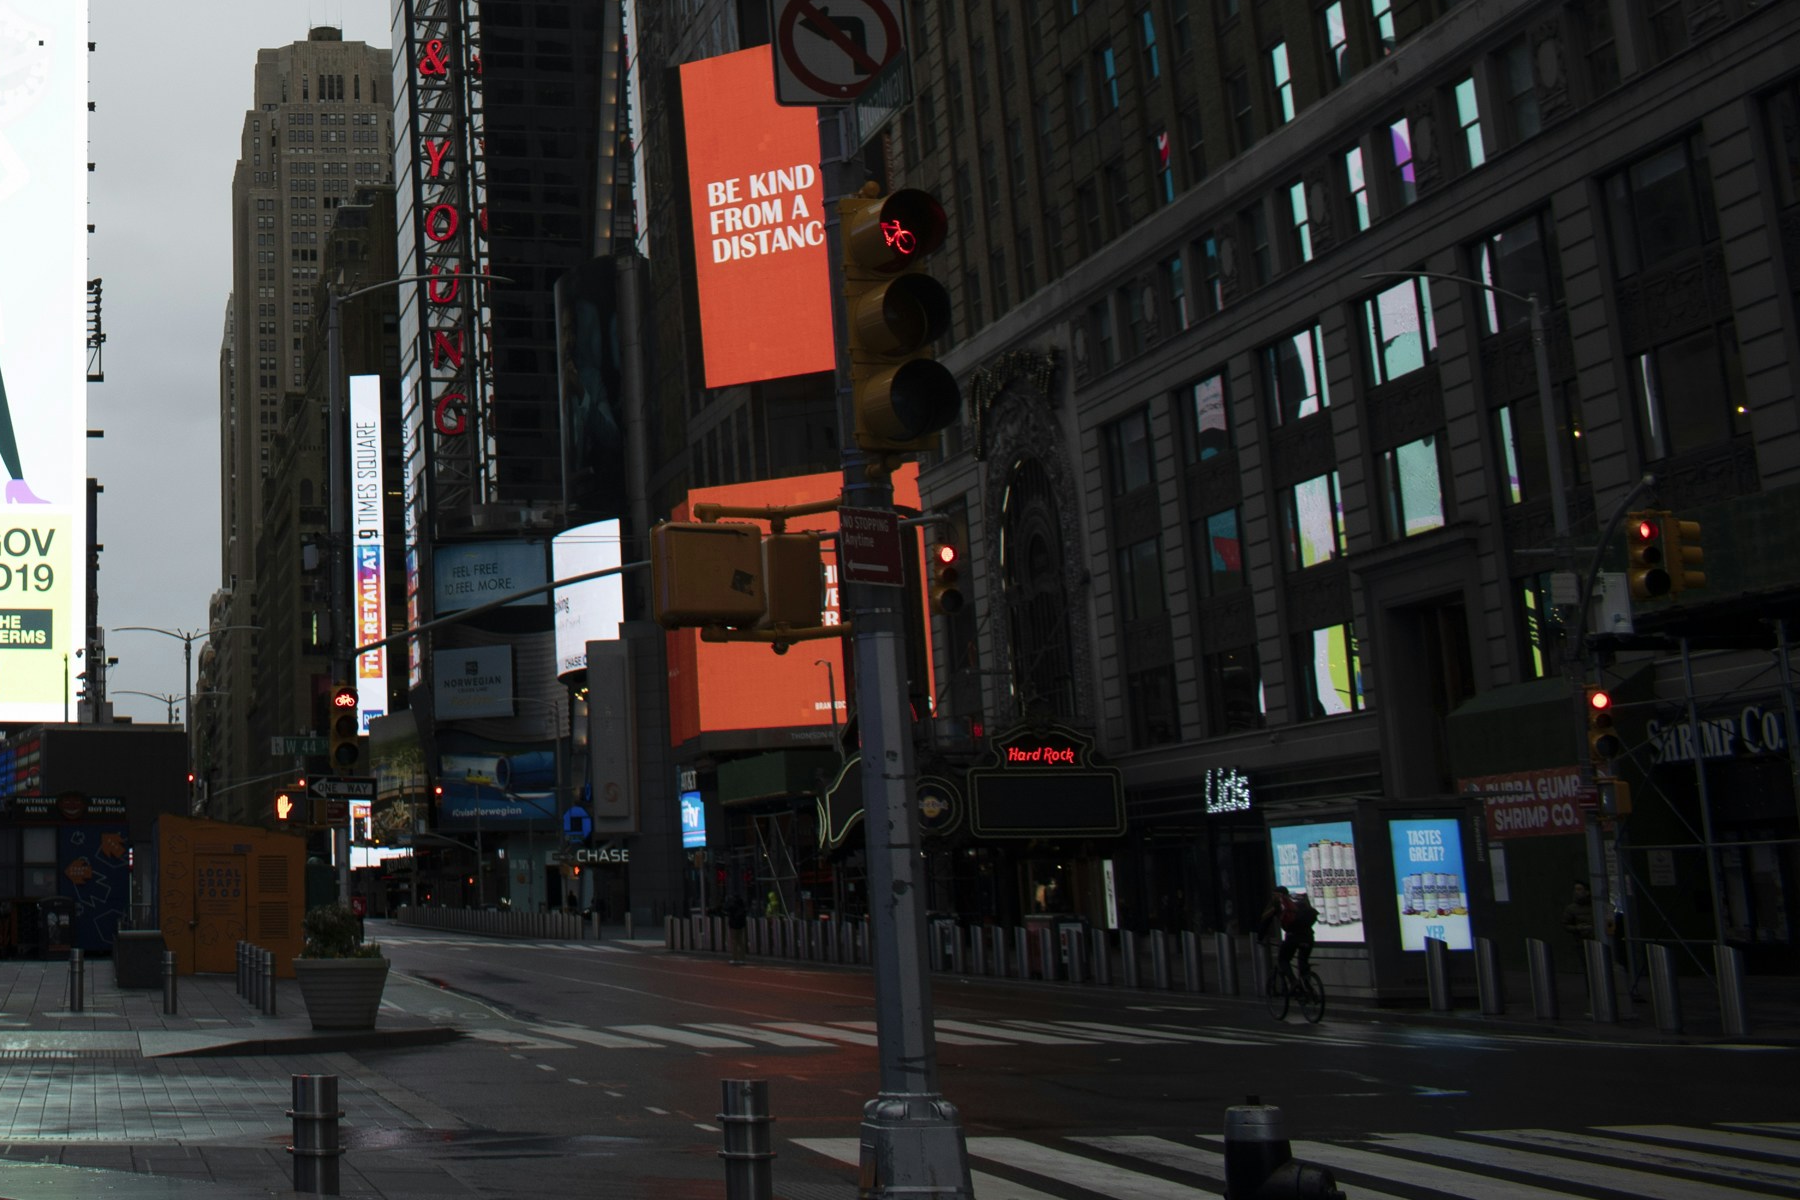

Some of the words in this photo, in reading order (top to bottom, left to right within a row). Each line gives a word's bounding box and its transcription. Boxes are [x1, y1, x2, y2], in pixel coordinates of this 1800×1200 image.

[419, 39, 449, 75] &
[707, 178, 743, 208] BE
[749, 164, 815, 199] KIND
[710, 200, 784, 235] FROM
[791, 194, 810, 219] A
[712, 220, 825, 264] DISTANC
[424, 140, 466, 435] YOUNG
[357, 421, 377, 480] SQUARE
[358, 484, 378, 525] TIMES
[843, 515, 854, 529] NO
[855, 516, 889, 533] STOPPING
[359, 529, 378, 540] 9
[844, 533, 875, 548] Anytime
[361, 548, 377, 570] AT
[453, 566, 470, 578] FEEL
[474, 563, 498, 575] FREE
[456, 582, 474, 594] FEEL
[478, 578, 515, 591] MORE.
[362, 573, 378, 636] RETAIL
[444, 676, 501, 688] NORWEGIAN
[286, 740, 296, 753] W
[302, 741, 316, 753] 44
[1008, 747, 1041, 762] Hard
[1043, 746, 1075, 765] Rock
[318, 783, 337, 793] ONE
[347, 783, 368, 793] WAY
[1204, 766, 1251, 814] Lids
[1486, 780, 1535, 804] BUBBA
[1537, 774, 1580, 800] GUMP
[1494, 804, 1549, 831] SHRIMP
[1552, 803, 1579, 826] CO.
[1407, 830, 1442, 845] TASTES
[577, 850, 629, 862] CHASE
[1409, 846, 1444, 862] GREAT?
[199, 868, 241, 878] LOCAL
